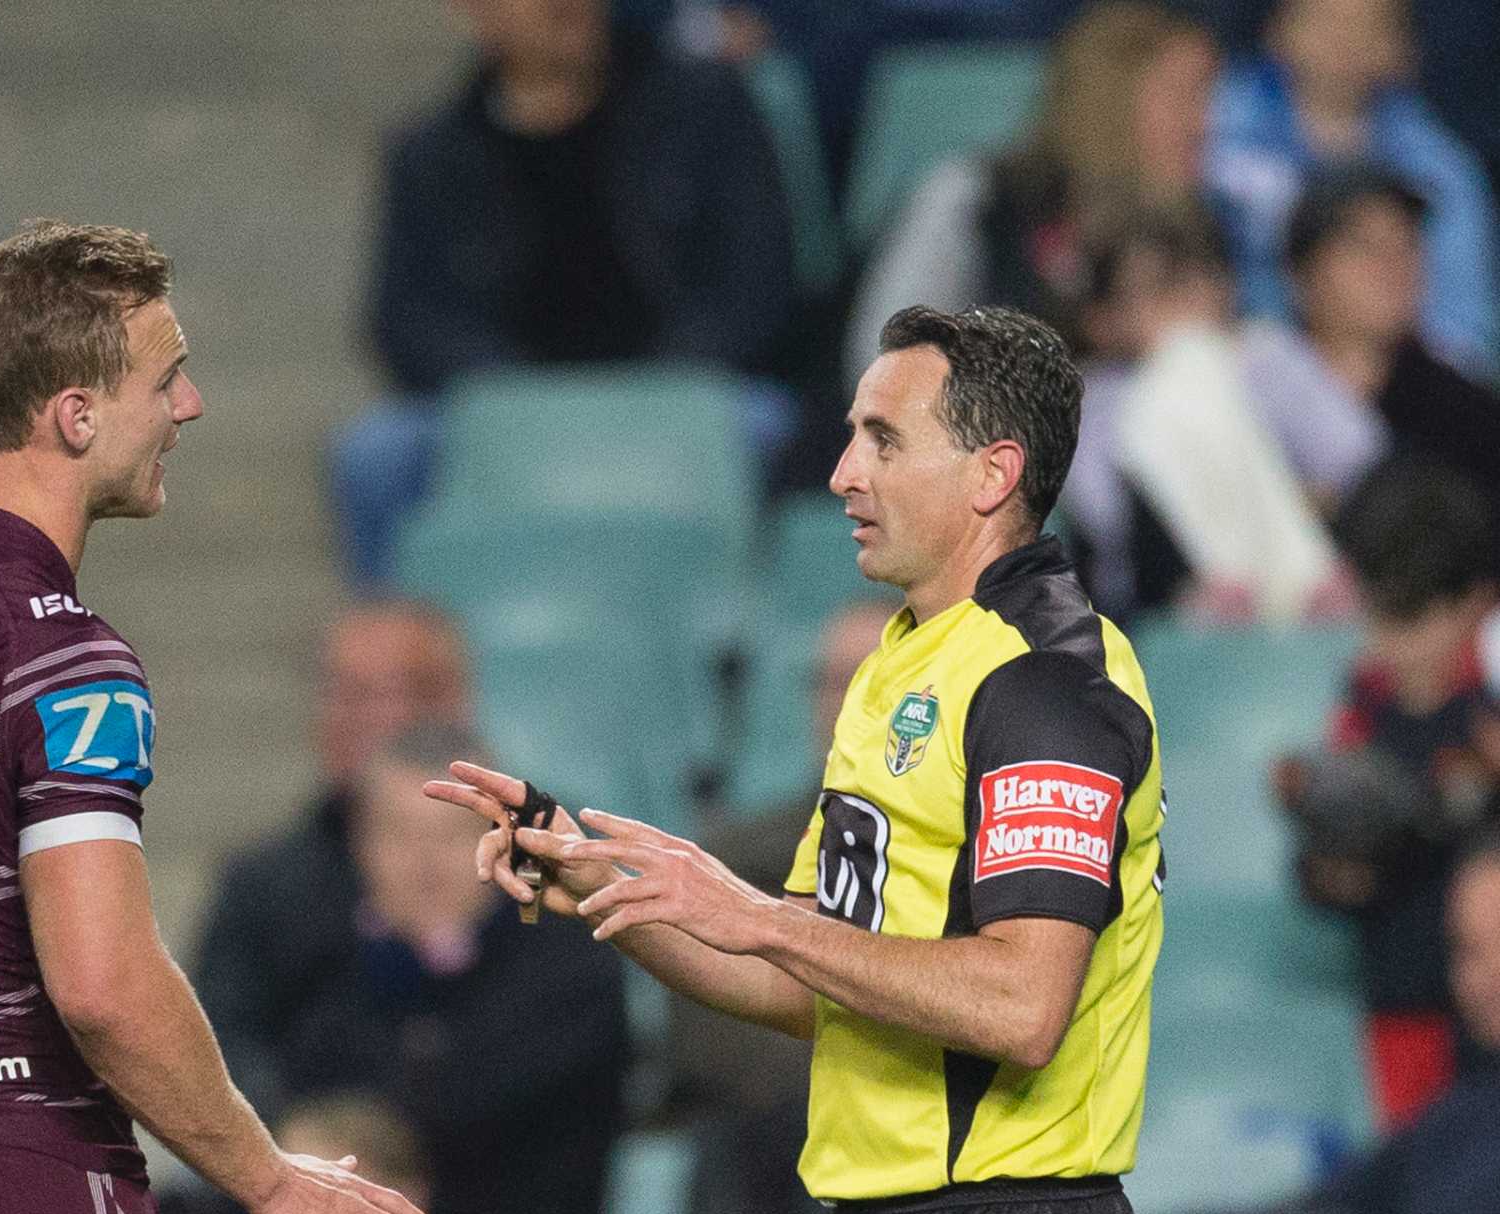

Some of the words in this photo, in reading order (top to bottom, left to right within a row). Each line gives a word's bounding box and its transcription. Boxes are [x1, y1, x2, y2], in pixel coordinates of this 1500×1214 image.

[52, 691, 156, 771] ZT
[902, 702, 931, 724] NRL
[993, 775, 1111, 820] Harvey
[984, 823, 1109, 863] Norman
